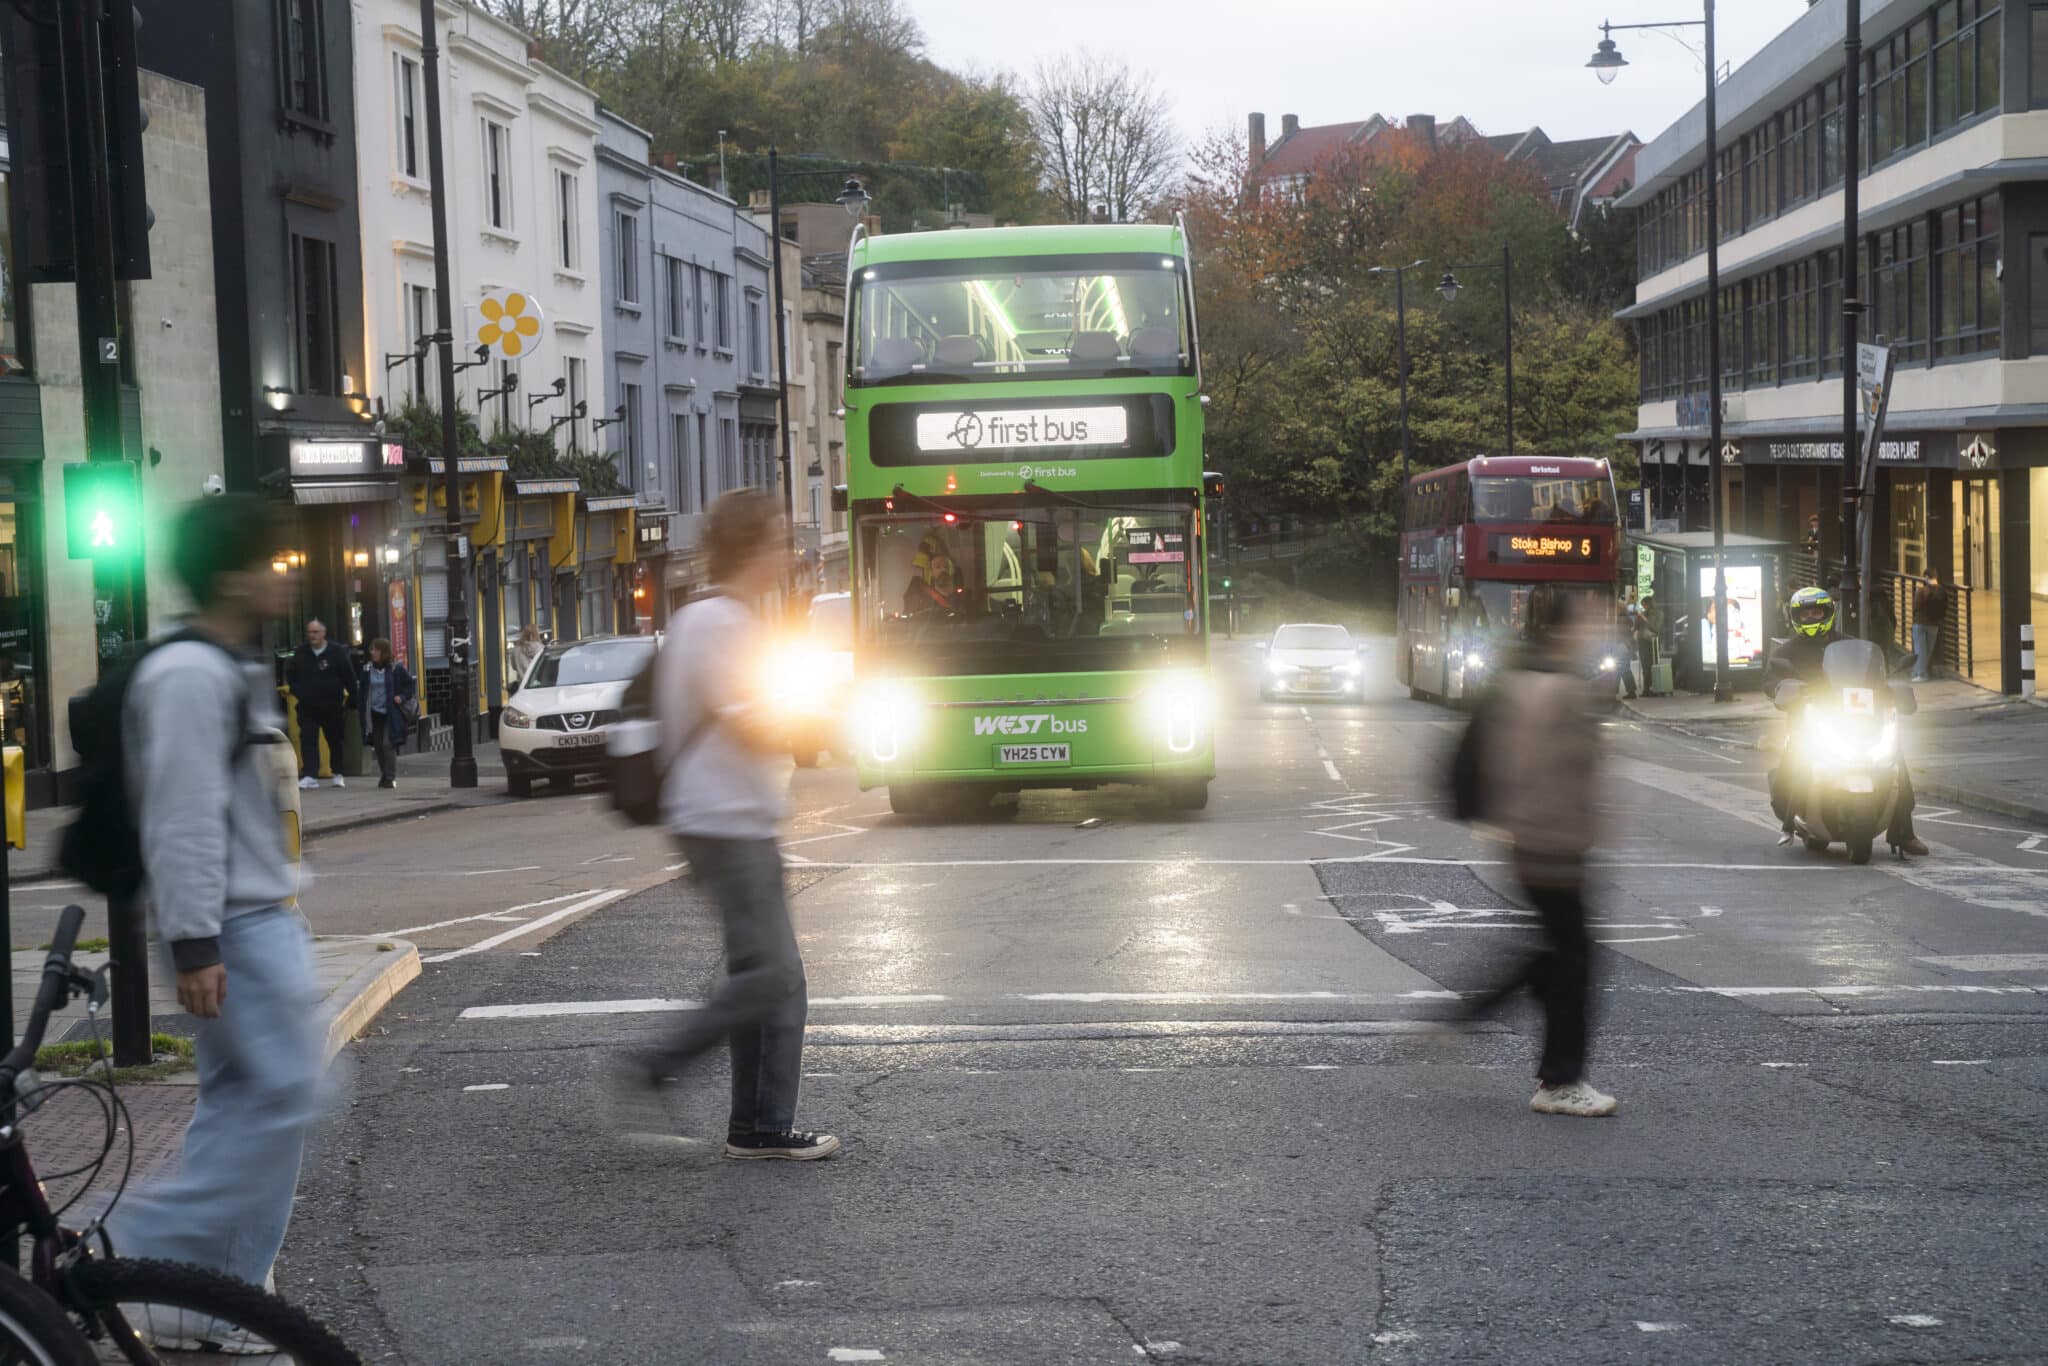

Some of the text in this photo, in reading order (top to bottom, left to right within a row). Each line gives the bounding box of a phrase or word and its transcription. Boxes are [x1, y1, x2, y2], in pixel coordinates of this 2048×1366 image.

[106, 342, 117, 359] 2
[988, 415, 1088, 444] first bus
[1034, 467, 1056, 477] first
[1058, 467, 1077, 476] bus
[1530, 465, 1560, 473] Bristol
[1511, 537, 1572, 552] Stoke Bishop
[1581, 539, 1591, 555] 5
[974, 713, 1088, 736] WEST bus
[1003, 746, 1067, 761] YH25 CYW
